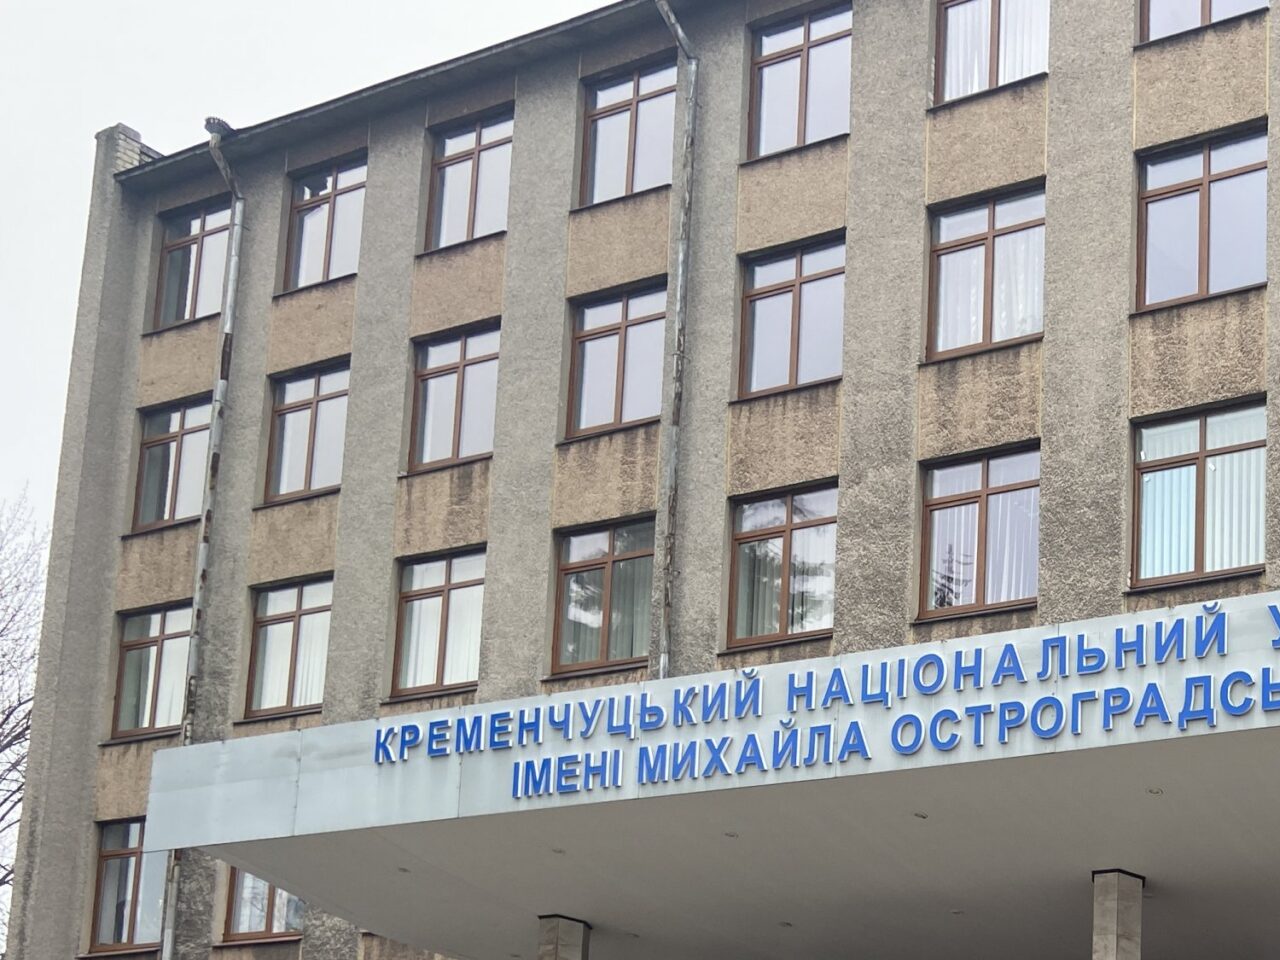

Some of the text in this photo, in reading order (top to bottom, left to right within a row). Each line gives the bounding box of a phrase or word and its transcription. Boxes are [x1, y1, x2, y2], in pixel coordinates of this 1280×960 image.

[374, 668, 763, 763] КРЕМЕНЧУЦЬКИЙ
[787, 602, 1228, 712] НАЦІОНАЛЬНИЙ
[512, 747, 624, 799] ІМЕНІ
[638, 719, 871, 784] МИХАЙЛА
